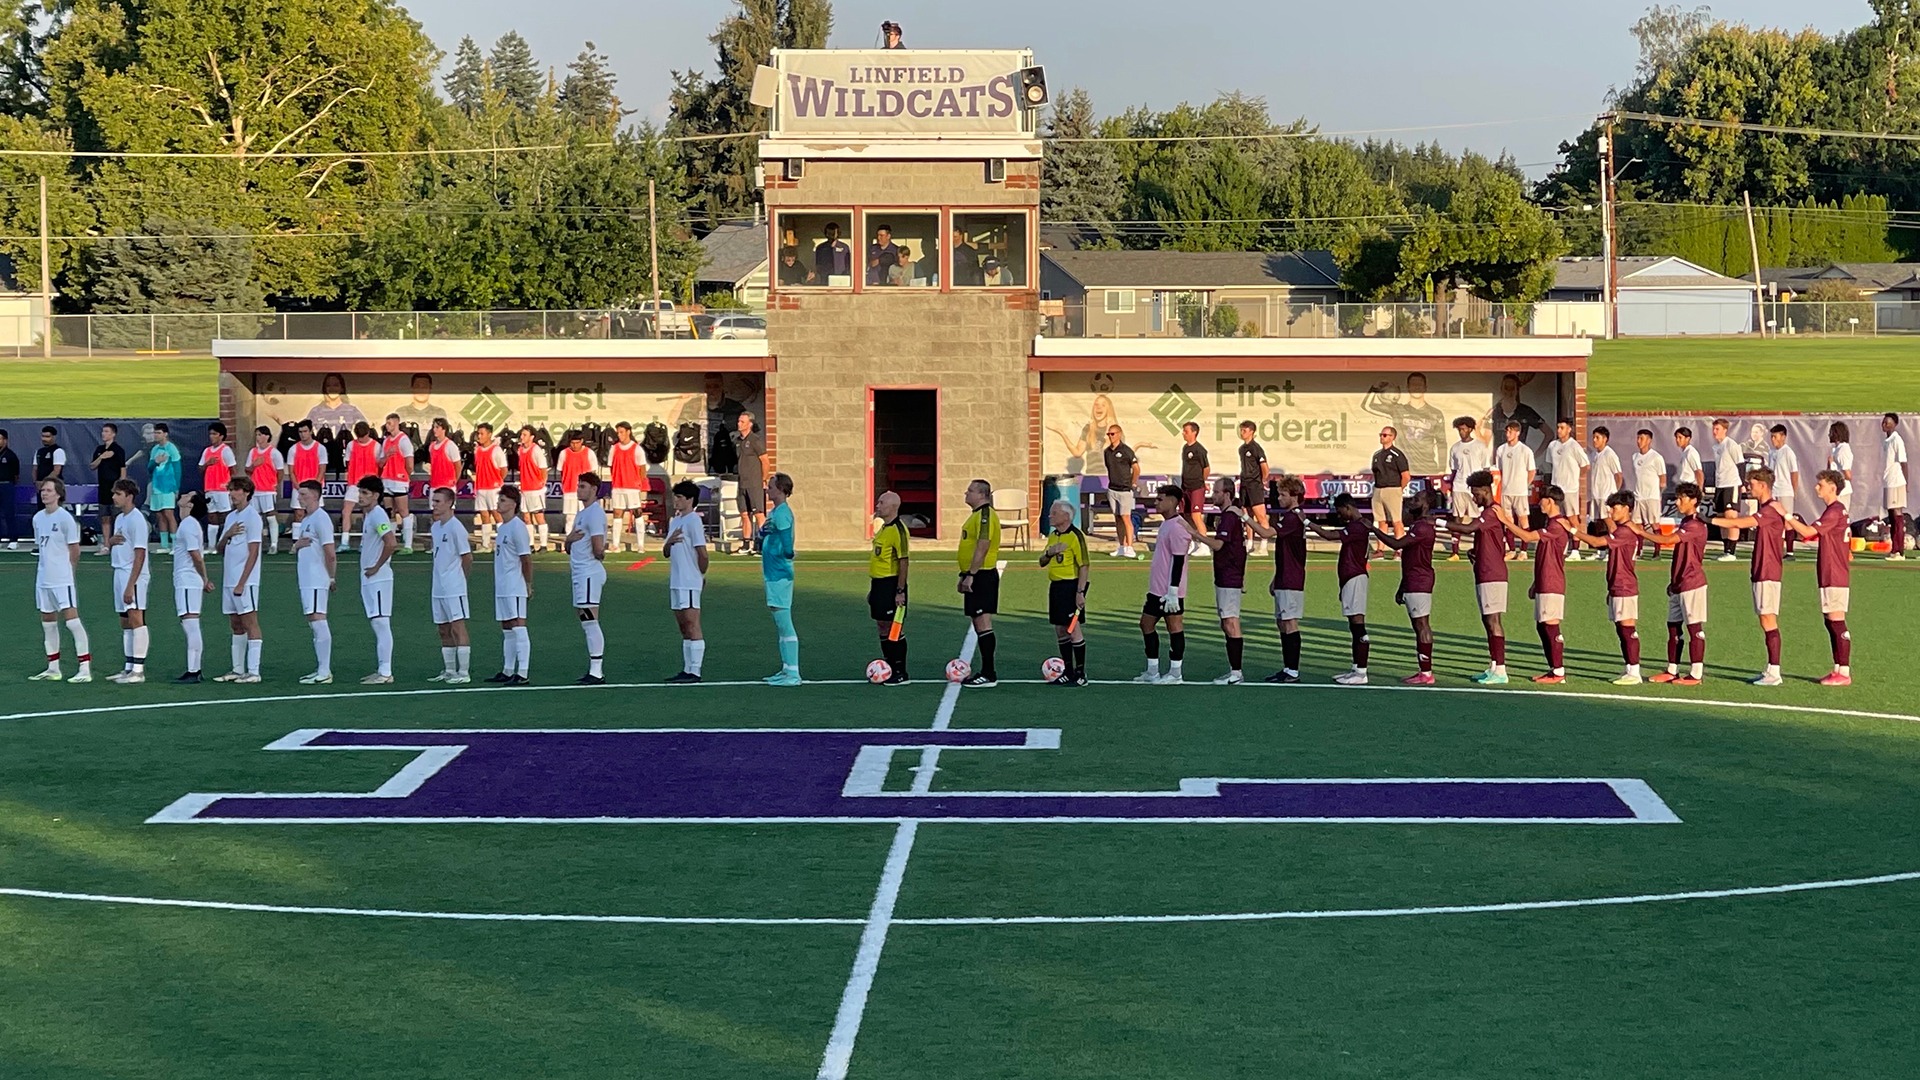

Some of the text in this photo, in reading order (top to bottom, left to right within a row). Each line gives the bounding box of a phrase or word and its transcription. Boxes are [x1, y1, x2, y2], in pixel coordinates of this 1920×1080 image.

[850, 67, 965, 84] LINFIELD
[787, 73, 1013, 118] WILDCATS
[527, 380, 606, 410] First
[1216, 378, 1295, 407] First
[380, 523, 389, 531] C
